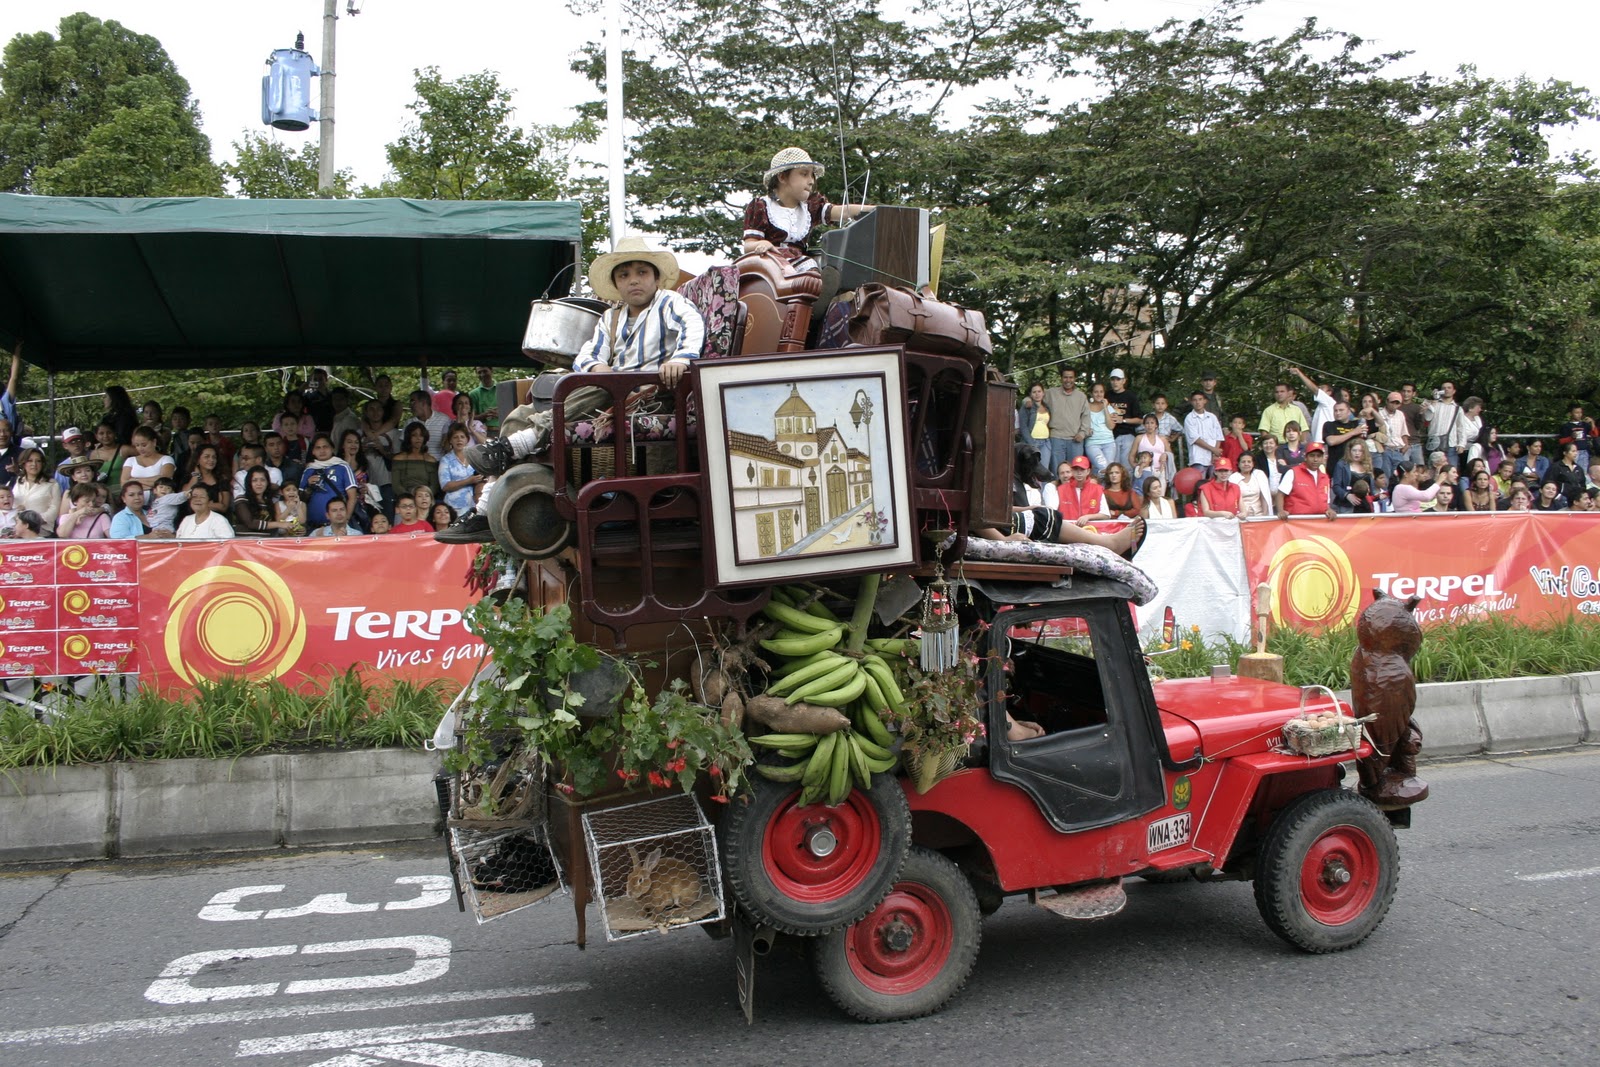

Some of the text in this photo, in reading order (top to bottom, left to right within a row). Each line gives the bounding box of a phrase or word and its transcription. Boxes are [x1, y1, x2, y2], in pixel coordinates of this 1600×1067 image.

[376, 648, 435, 670] Vives
[1149, 816, 1190, 848] WNA 334
